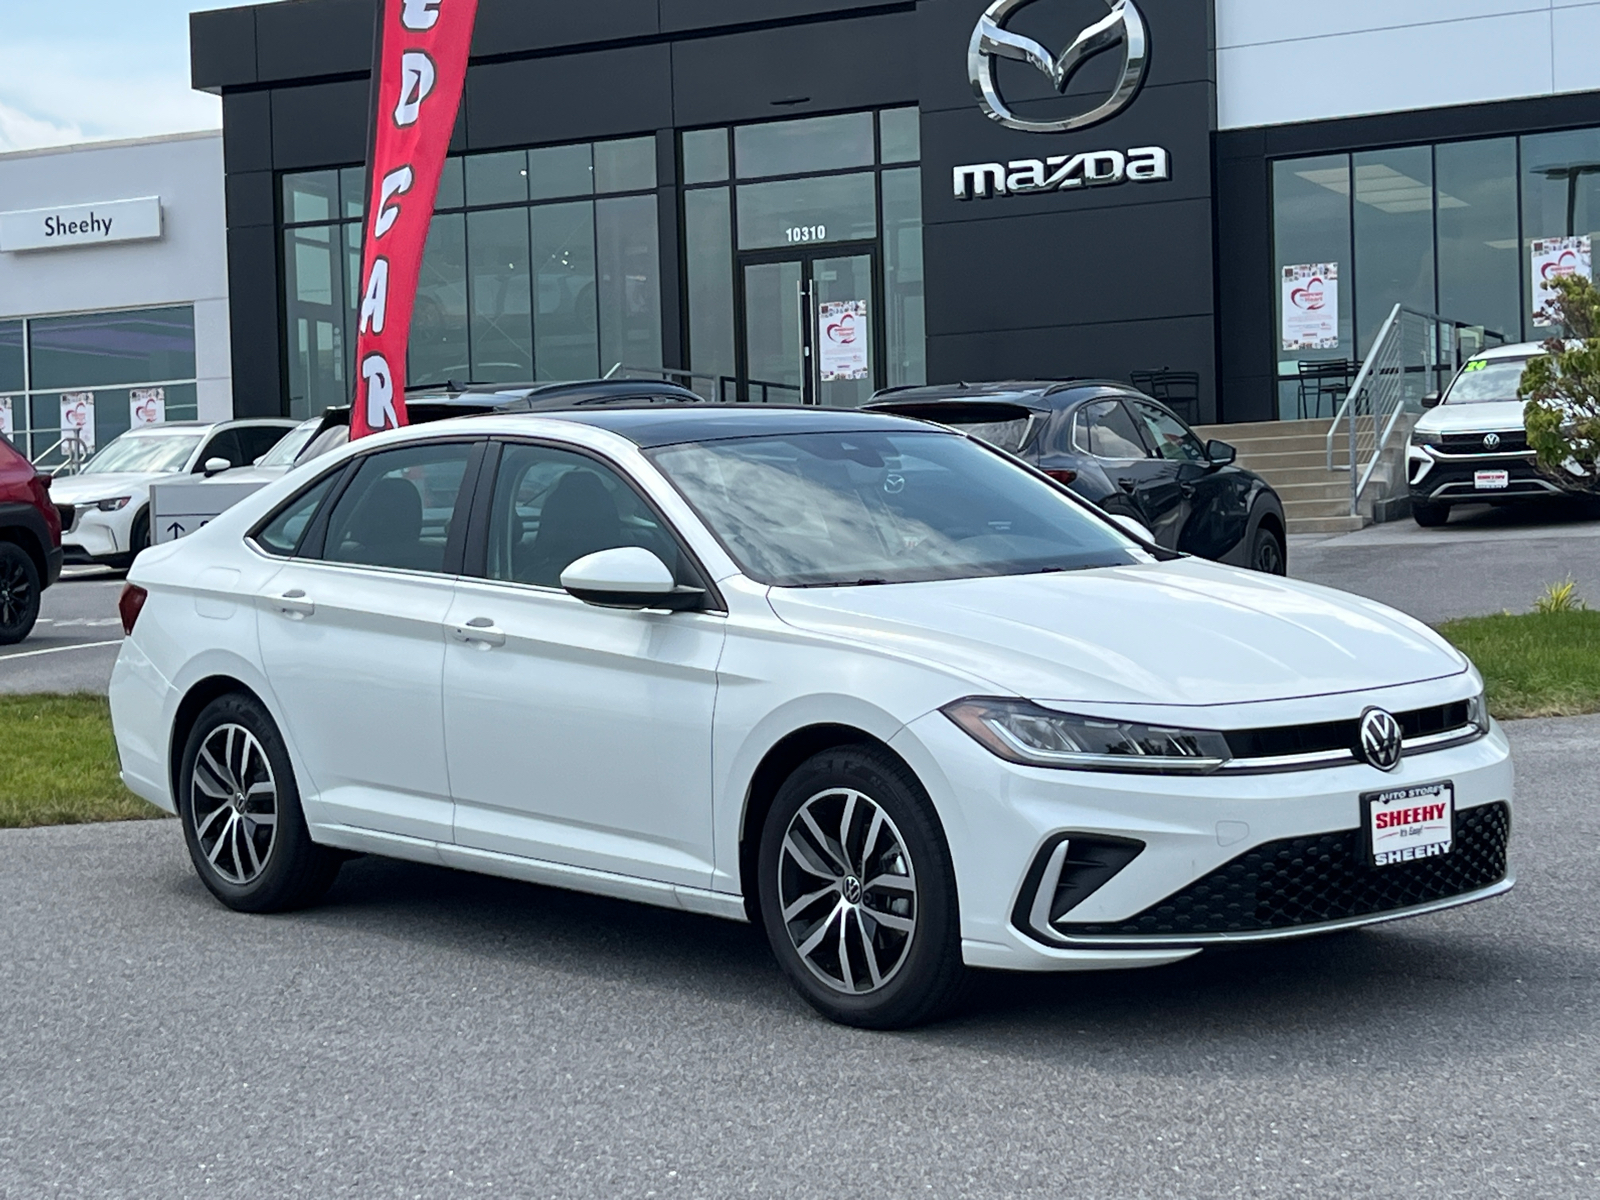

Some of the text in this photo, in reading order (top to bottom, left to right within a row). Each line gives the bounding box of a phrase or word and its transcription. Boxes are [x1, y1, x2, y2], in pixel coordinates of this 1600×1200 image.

[44, 211, 113, 237] Sheehy
[785, 225, 826, 242] 10310
[360, 163, 415, 430] CAR
[1378, 784, 1445, 802] AUTO STORES
[1375, 802, 1447, 830] SHEEHY
[1374, 840, 1453, 867] SHEEHY
